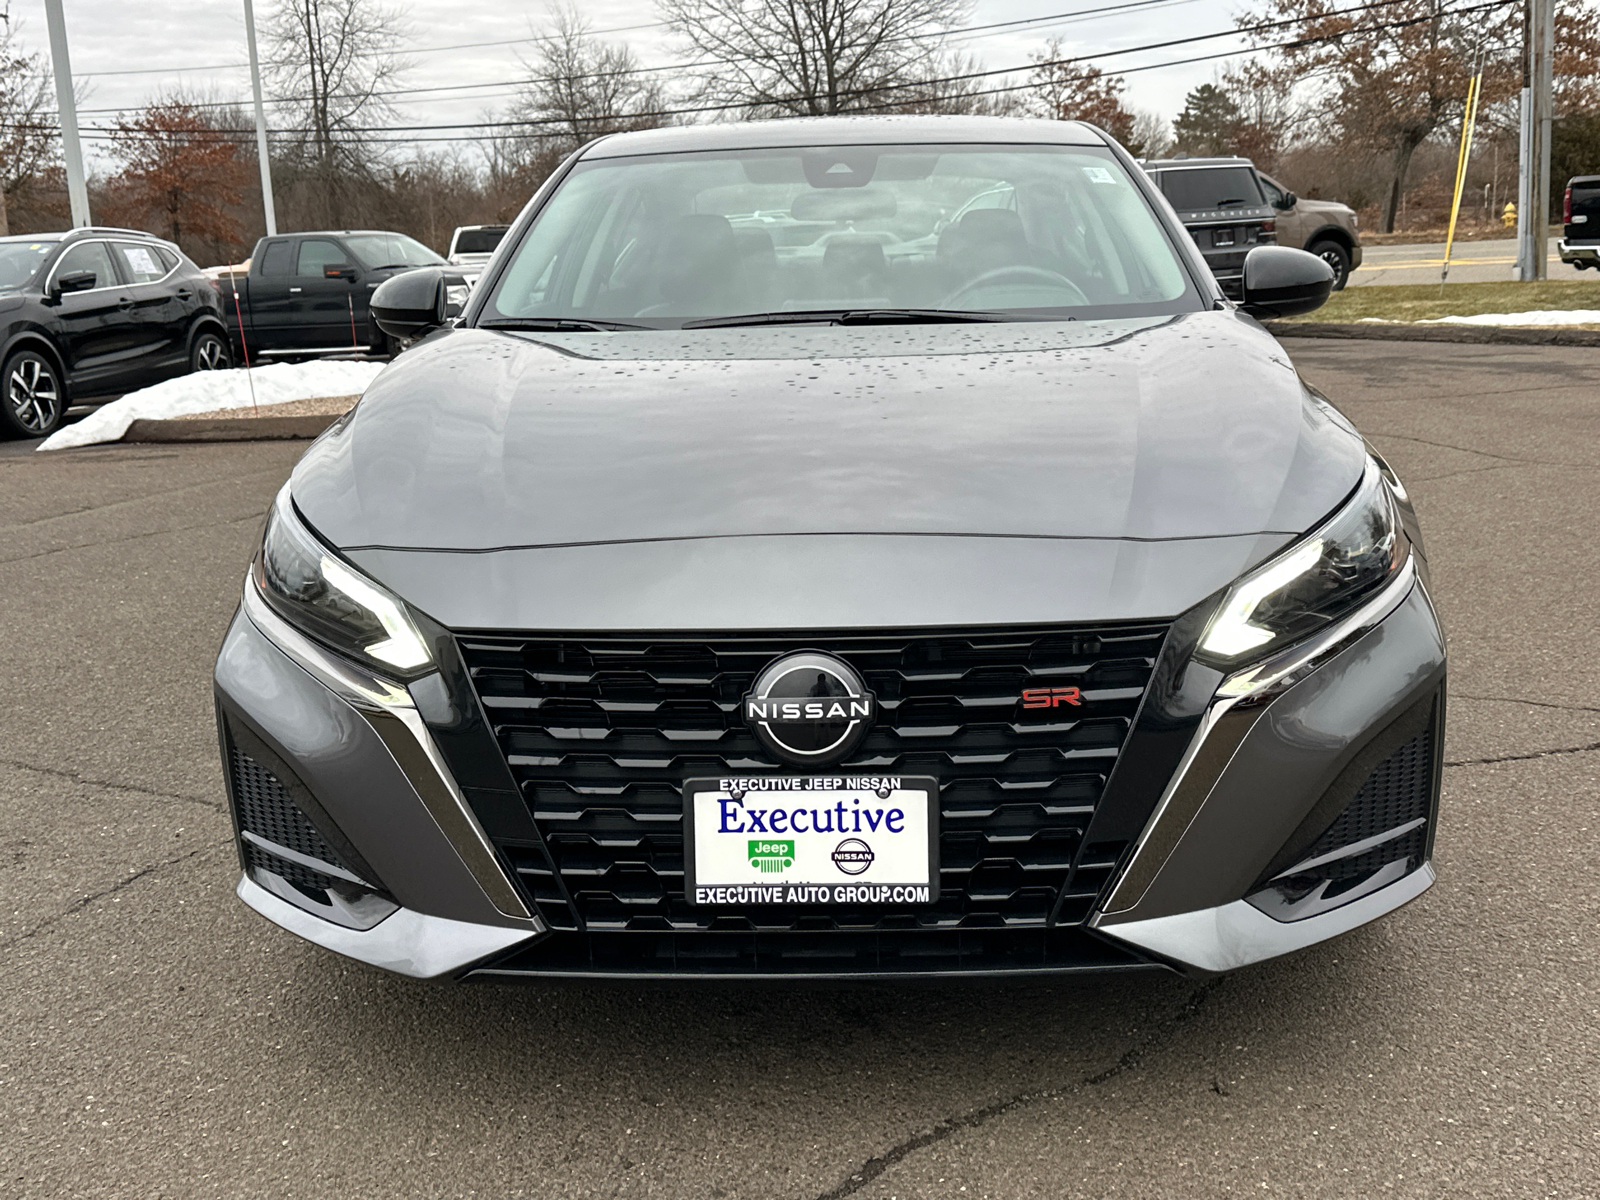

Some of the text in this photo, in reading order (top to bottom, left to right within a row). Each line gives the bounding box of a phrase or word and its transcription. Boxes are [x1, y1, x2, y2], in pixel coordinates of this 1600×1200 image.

[1022, 687, 1081, 709] SR
[749, 700, 869, 719] NISSAN
[719, 777, 901, 791] EXECUTIVE JEEP NISSAN
[717, 799, 905, 834] Executive
[754, 842, 788, 856] Jeep
[834, 852, 872, 861] NISSAN
[695, 887, 783, 904] EXECUTIVE
[786, 886, 830, 903] AUTO
